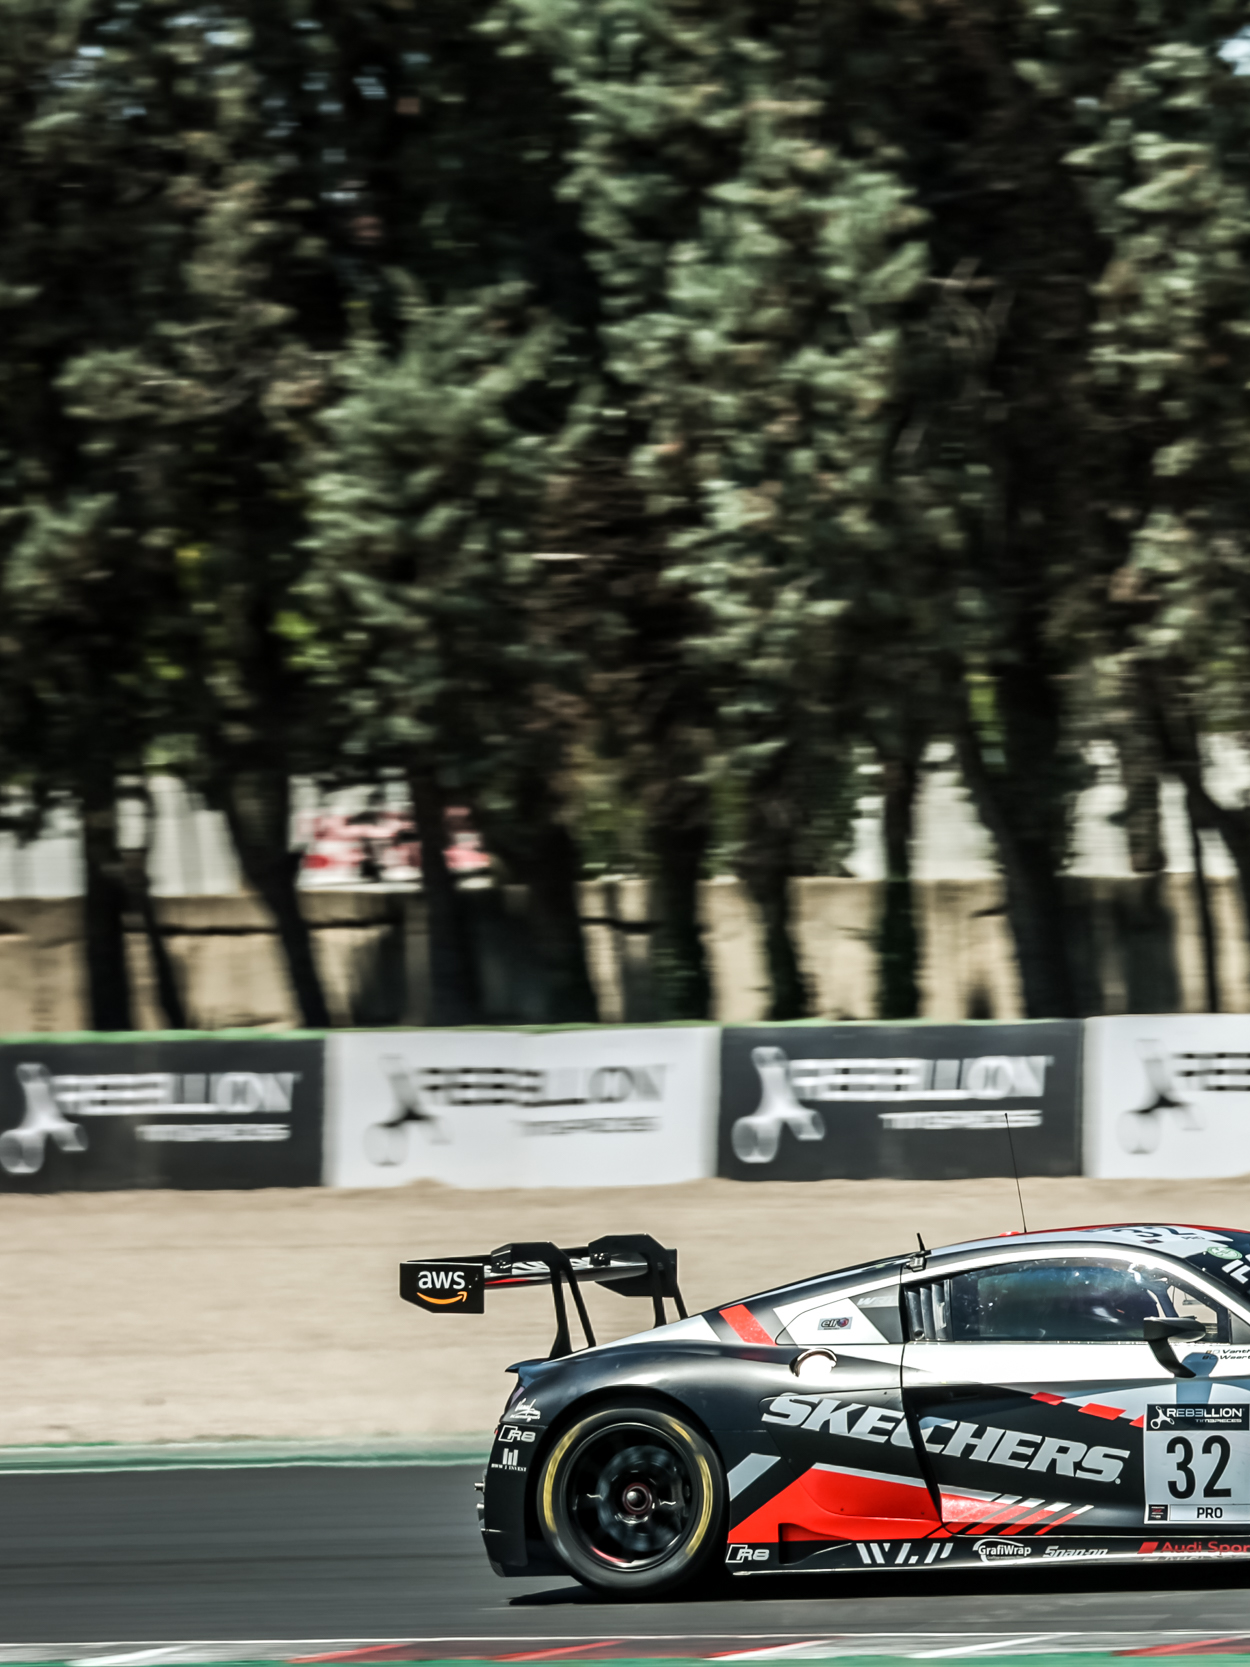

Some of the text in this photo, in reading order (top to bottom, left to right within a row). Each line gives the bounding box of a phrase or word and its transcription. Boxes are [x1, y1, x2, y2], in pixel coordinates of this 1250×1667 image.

[420, 1065, 667, 1106] REBELLION
[789, 1056, 1045, 1101] REBELLION
[54, 1072, 294, 1115] REBELLION
[418, 1270, 465, 1289] aws
[1166, 1408, 1242, 1418] REBELLION
[503, 1427, 536, 1442] R8
[761, 1395, 1131, 1483] SKECHERS
[1166, 1435, 1232, 1499] 32
[1196, 1507, 1223, 1519] PRO
[731, 1547, 769, 1561] R8
[978, 1544, 1032, 1557] GrafiWrap
[1160, 1541, 1205, 1554] Audi
